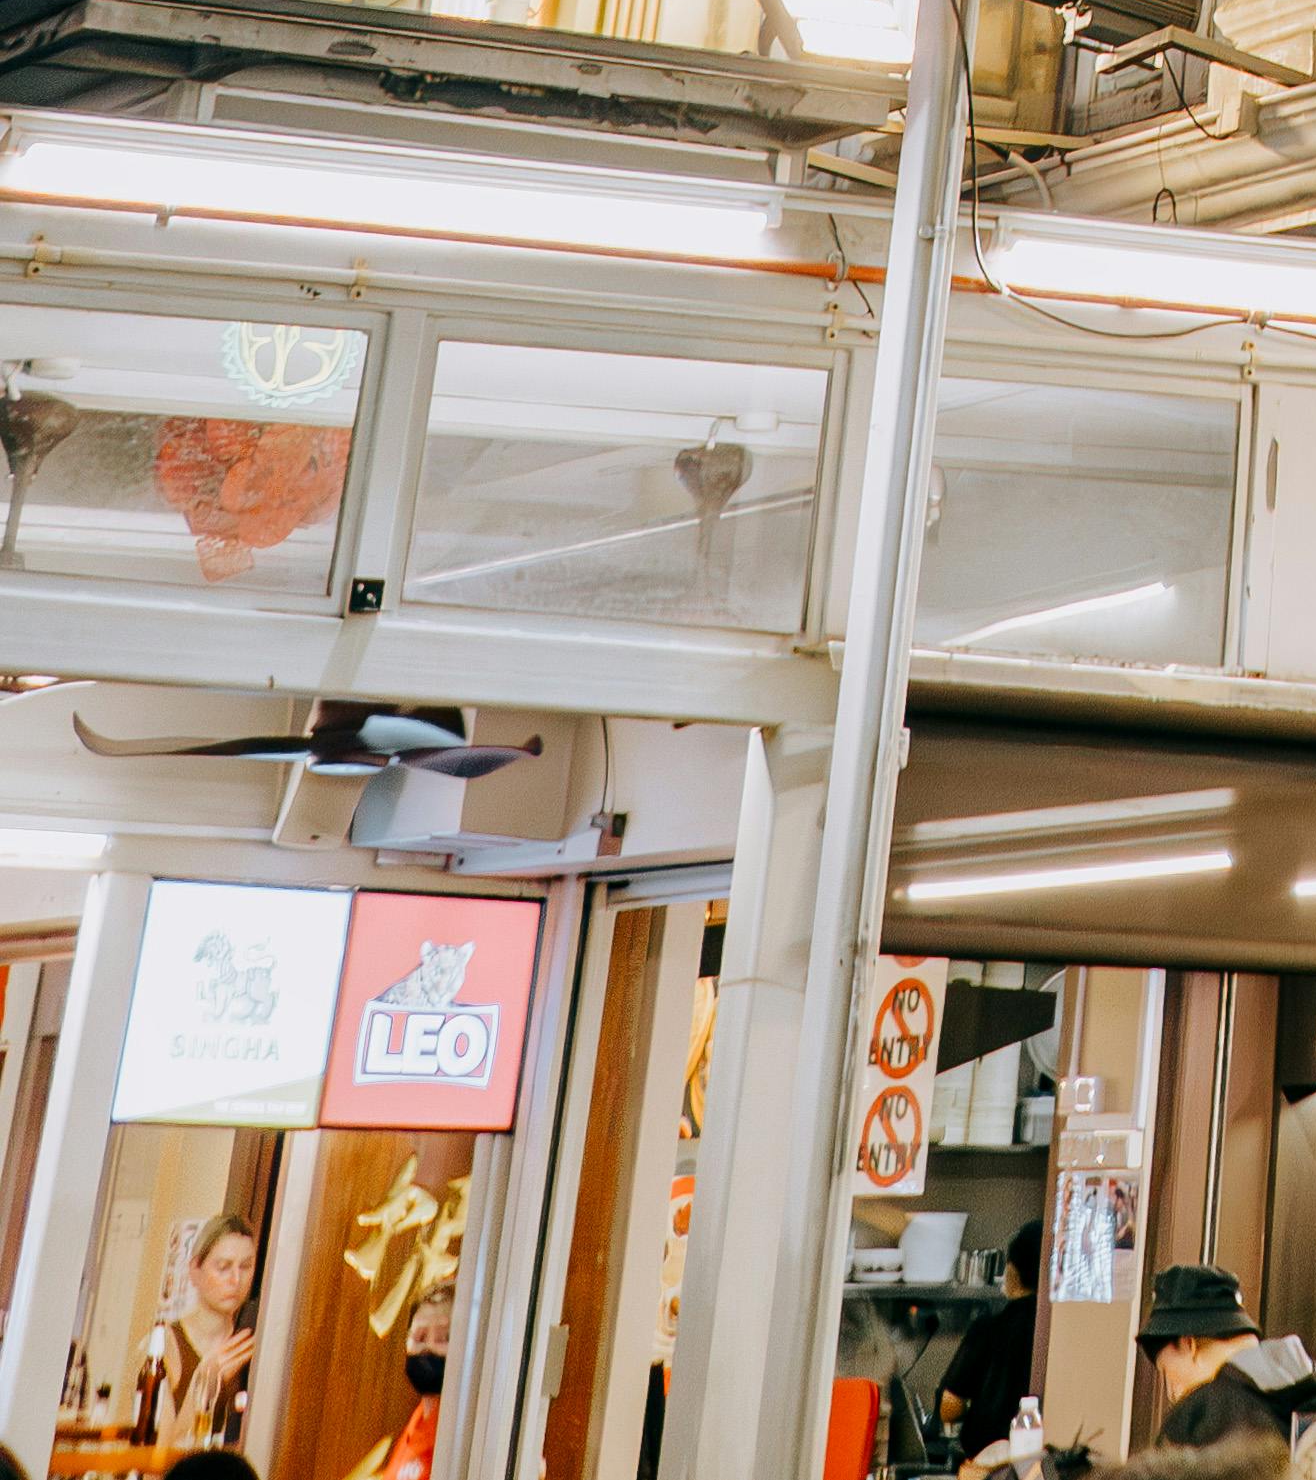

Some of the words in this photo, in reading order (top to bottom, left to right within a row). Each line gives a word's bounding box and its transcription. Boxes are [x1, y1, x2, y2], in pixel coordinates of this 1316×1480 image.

[892, 987, 921, 1013] NO
[169, 1033, 281, 1061] SINGHA
[363, 1011, 490, 1077] LEO
[880, 1093, 909, 1121] NO
